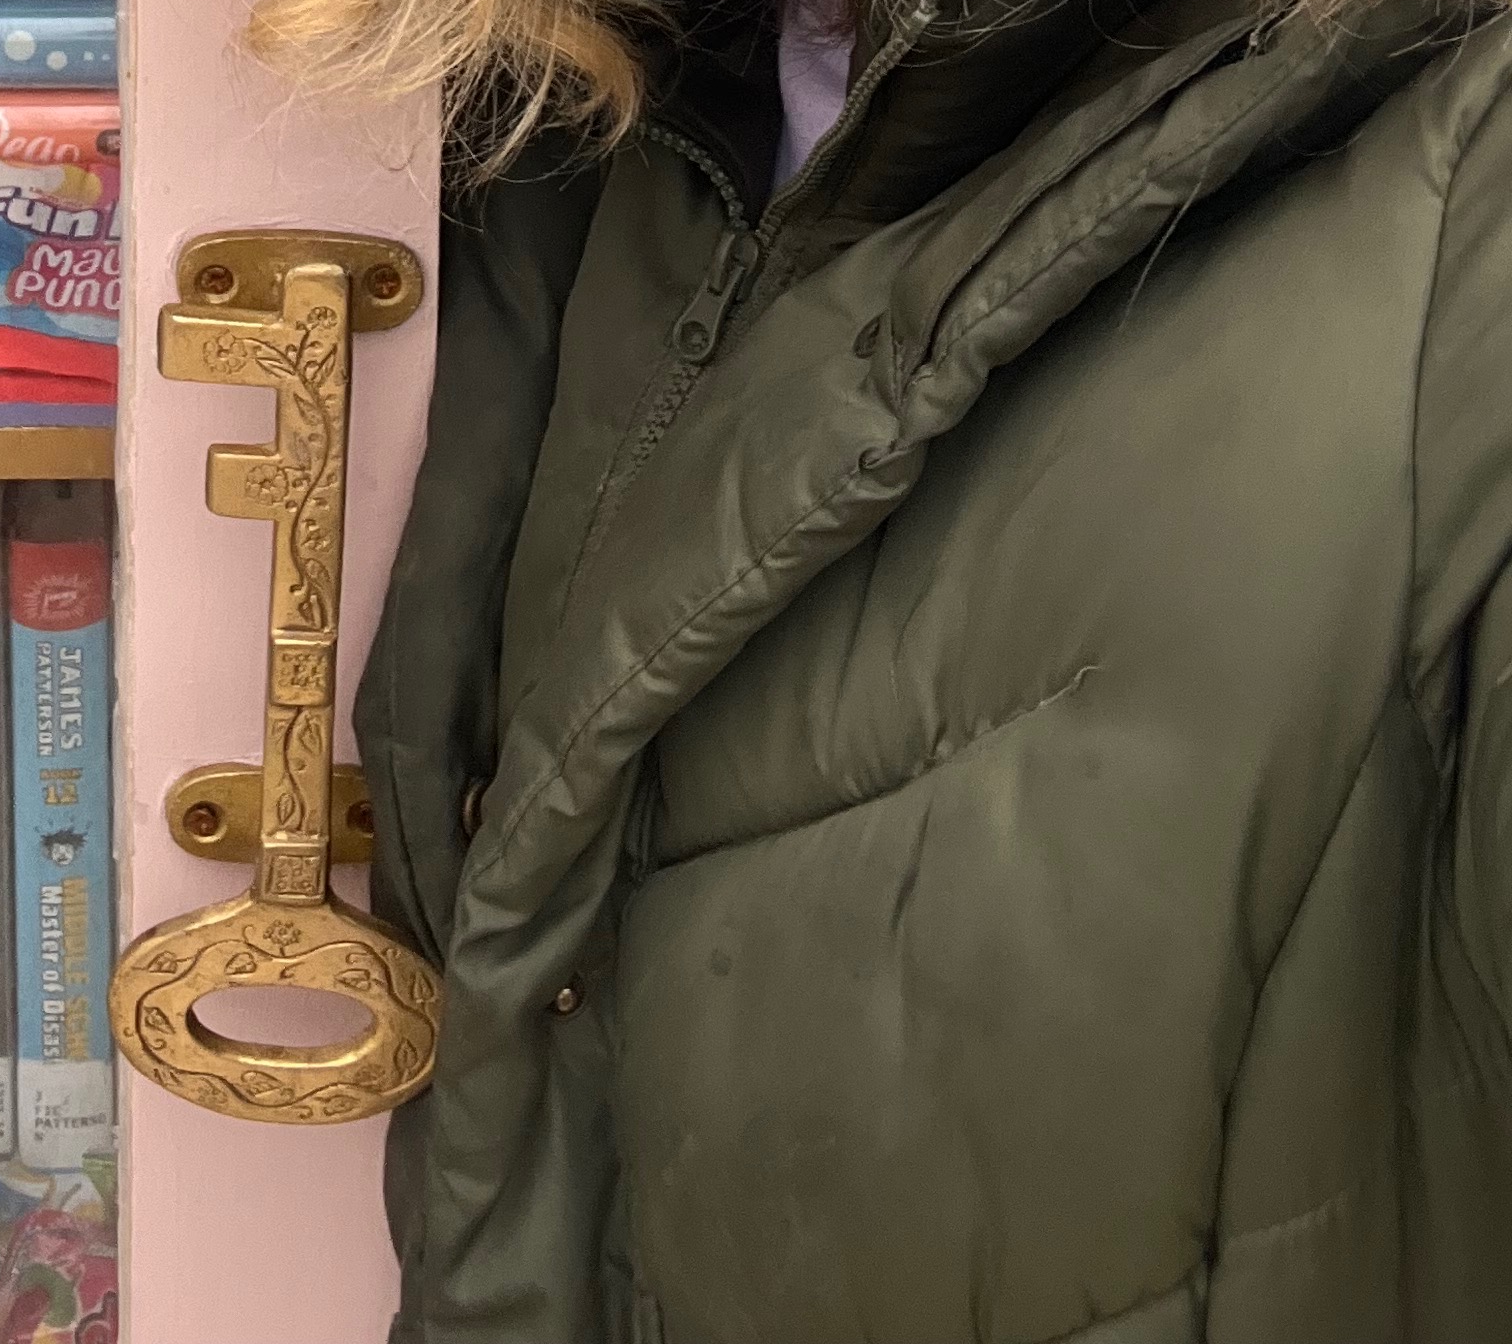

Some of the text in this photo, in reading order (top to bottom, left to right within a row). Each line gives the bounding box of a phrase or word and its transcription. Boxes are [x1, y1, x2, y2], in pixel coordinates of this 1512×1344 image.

[37, 641, 54, 757] PATTERSON
[59, 645, 83, 751] JAMES
[40, 885, 65, 964] Master
[62, 876, 88, 985] MIDDLE
[42, 969, 66, 993] of
